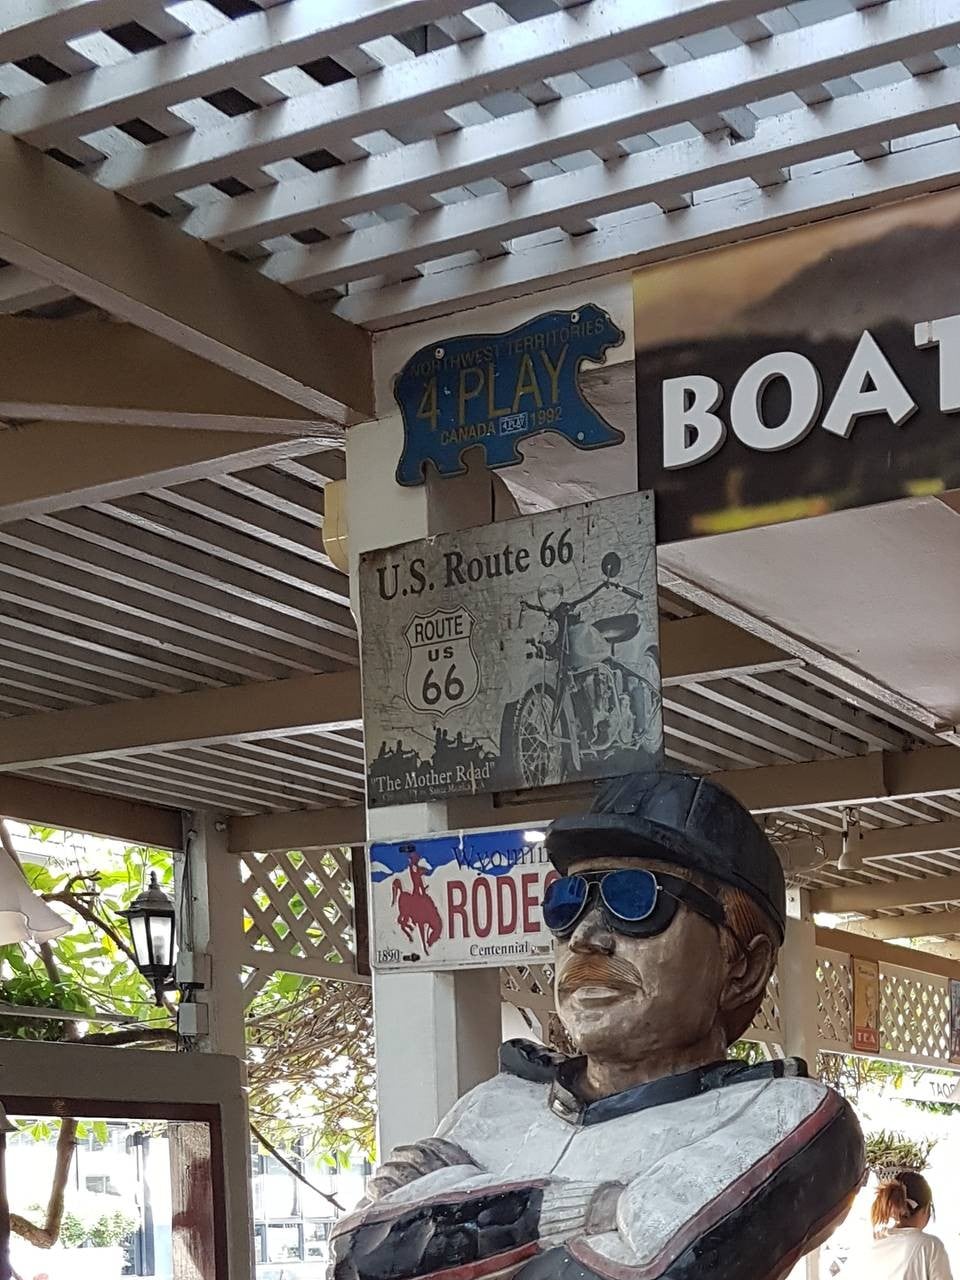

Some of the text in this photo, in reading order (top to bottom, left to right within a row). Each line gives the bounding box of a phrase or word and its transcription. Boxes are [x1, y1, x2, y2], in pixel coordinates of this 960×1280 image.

[411, 318, 606, 378] NORTHWEST TERRITORIES
[416, 344, 569, 431] 4 PLAY
[440, 407, 563, 446] CANADA 1992
[376, 528, 575, 601] U.S. Route 66
[414, 615, 464, 643] ROUTE
[428, 646, 454, 662] US
[422, 664, 465, 705] 66
[404, 769, 453, 789] Mother
[456, 762, 495, 783] Road"
[470, 941, 528, 957] Centennial
